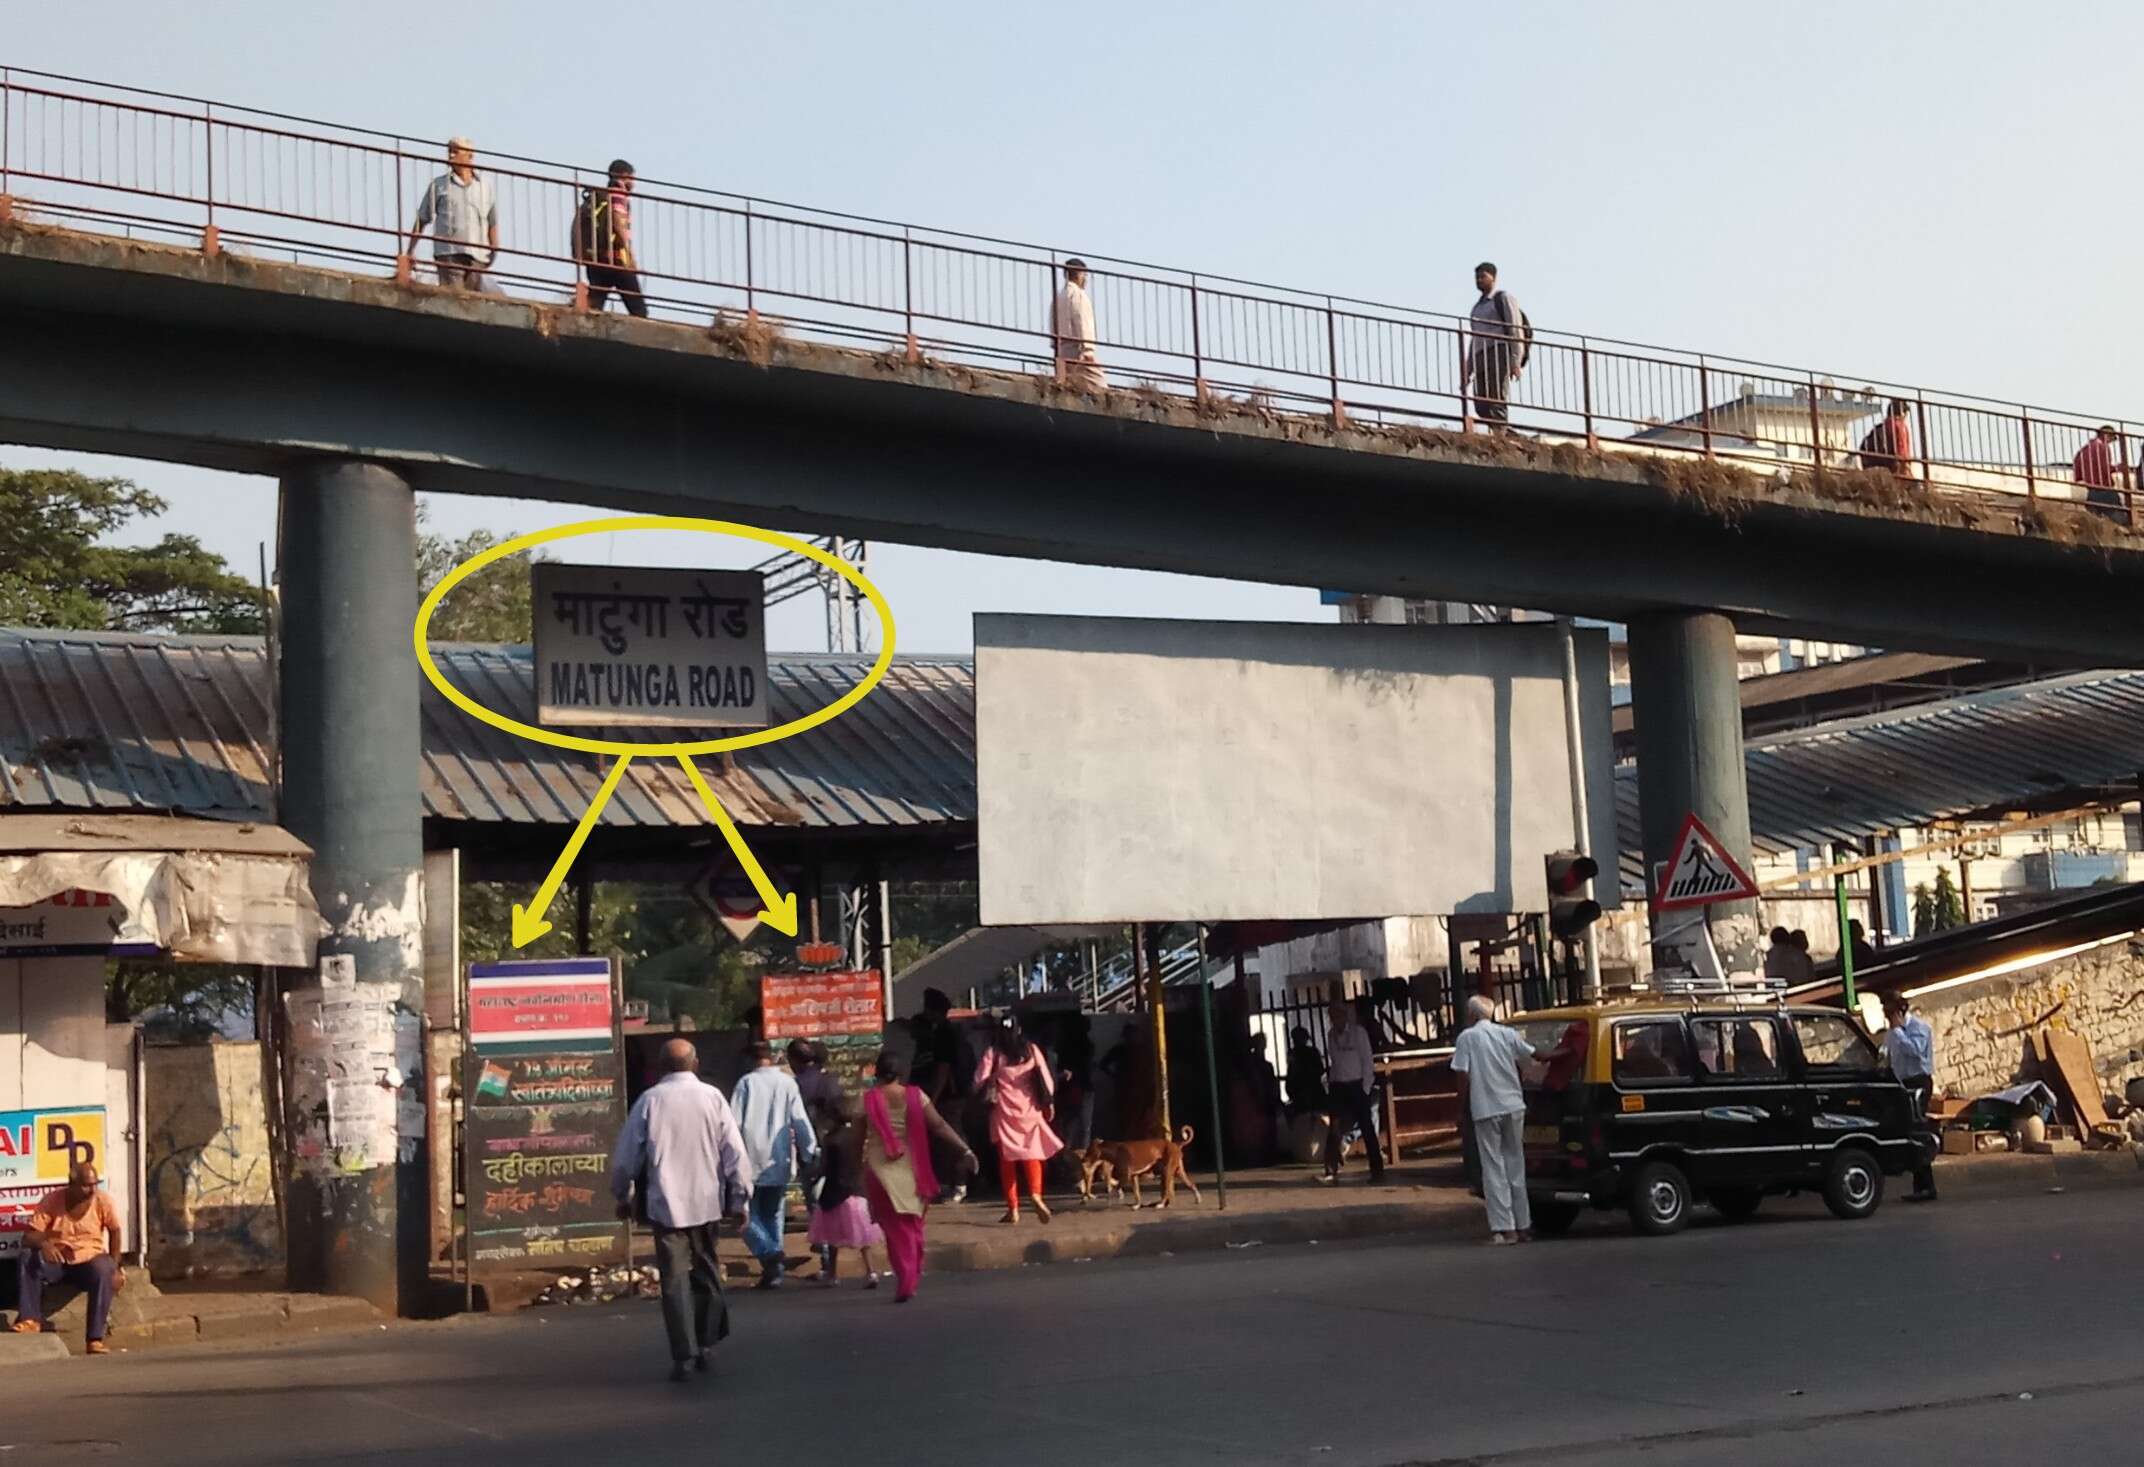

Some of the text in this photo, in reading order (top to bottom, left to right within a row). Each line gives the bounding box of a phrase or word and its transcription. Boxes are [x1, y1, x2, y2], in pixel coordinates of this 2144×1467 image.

[552, 580, 752, 655] माटुंगा रोड
[551, 662, 755, 708] MATUNGA ROAD
